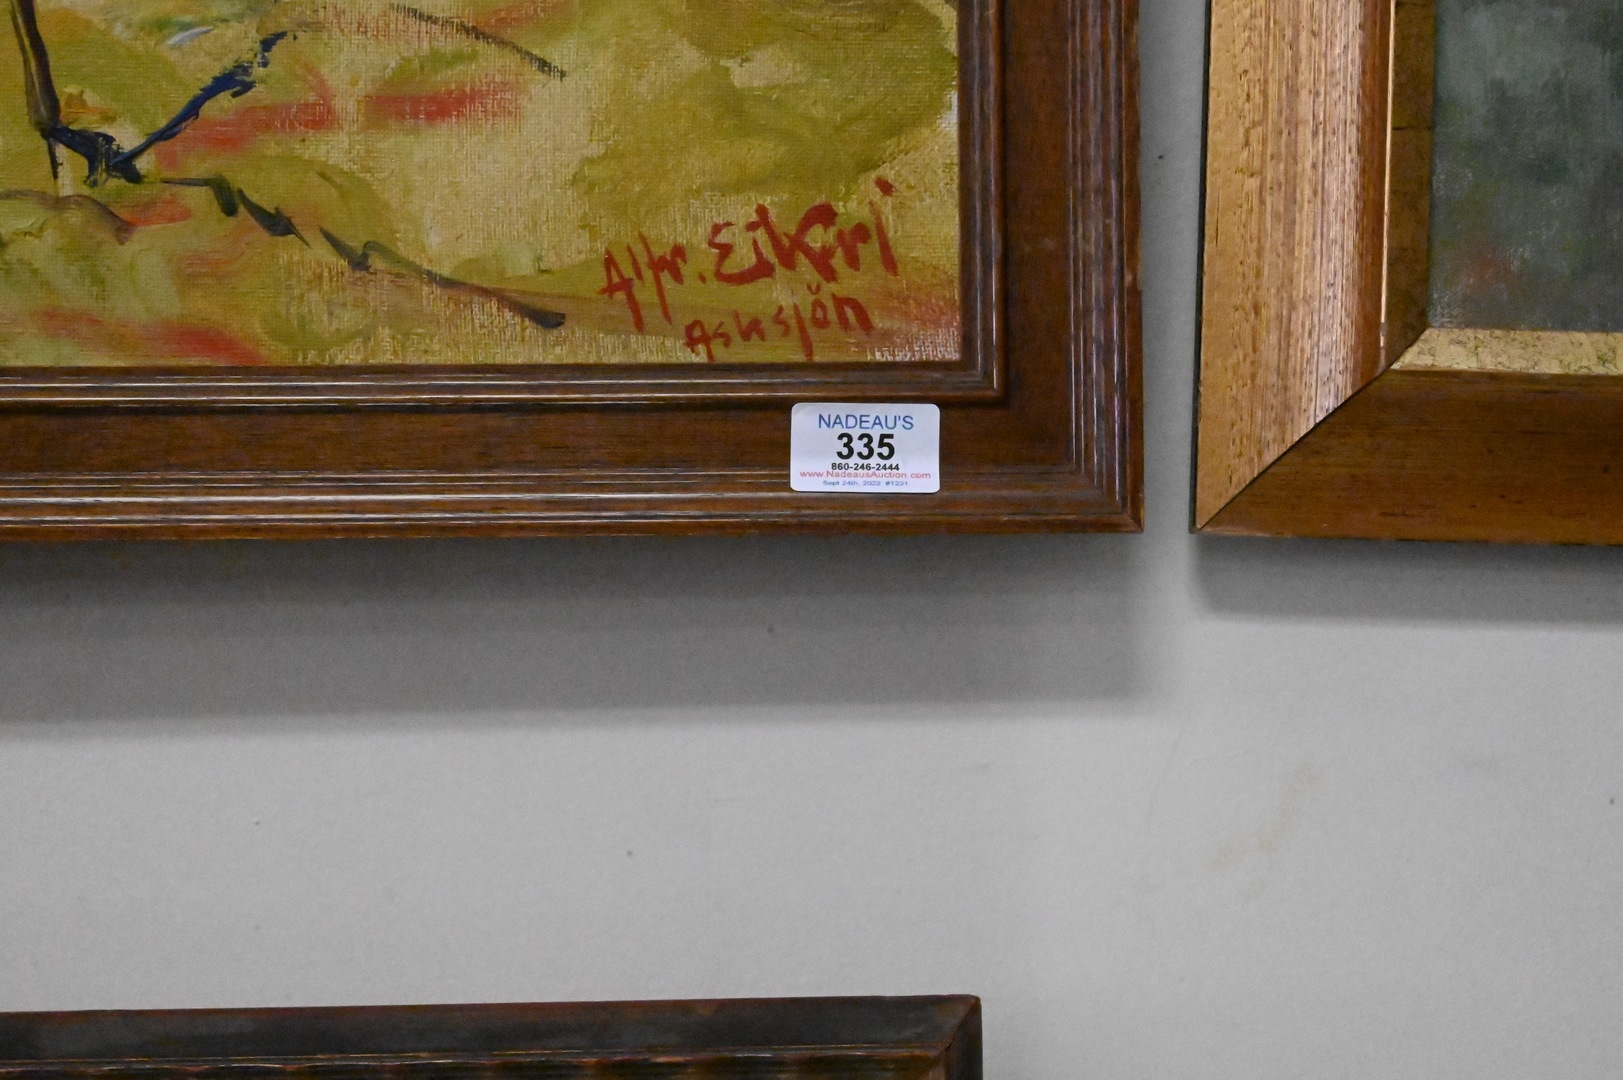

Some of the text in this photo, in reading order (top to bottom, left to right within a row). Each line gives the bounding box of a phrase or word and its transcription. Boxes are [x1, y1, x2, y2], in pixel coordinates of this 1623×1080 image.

[818, 413, 914, 431] NADEAU'S
[836, 432, 896, 461] 335
[831, 462, 900, 472] 860-246-2444
